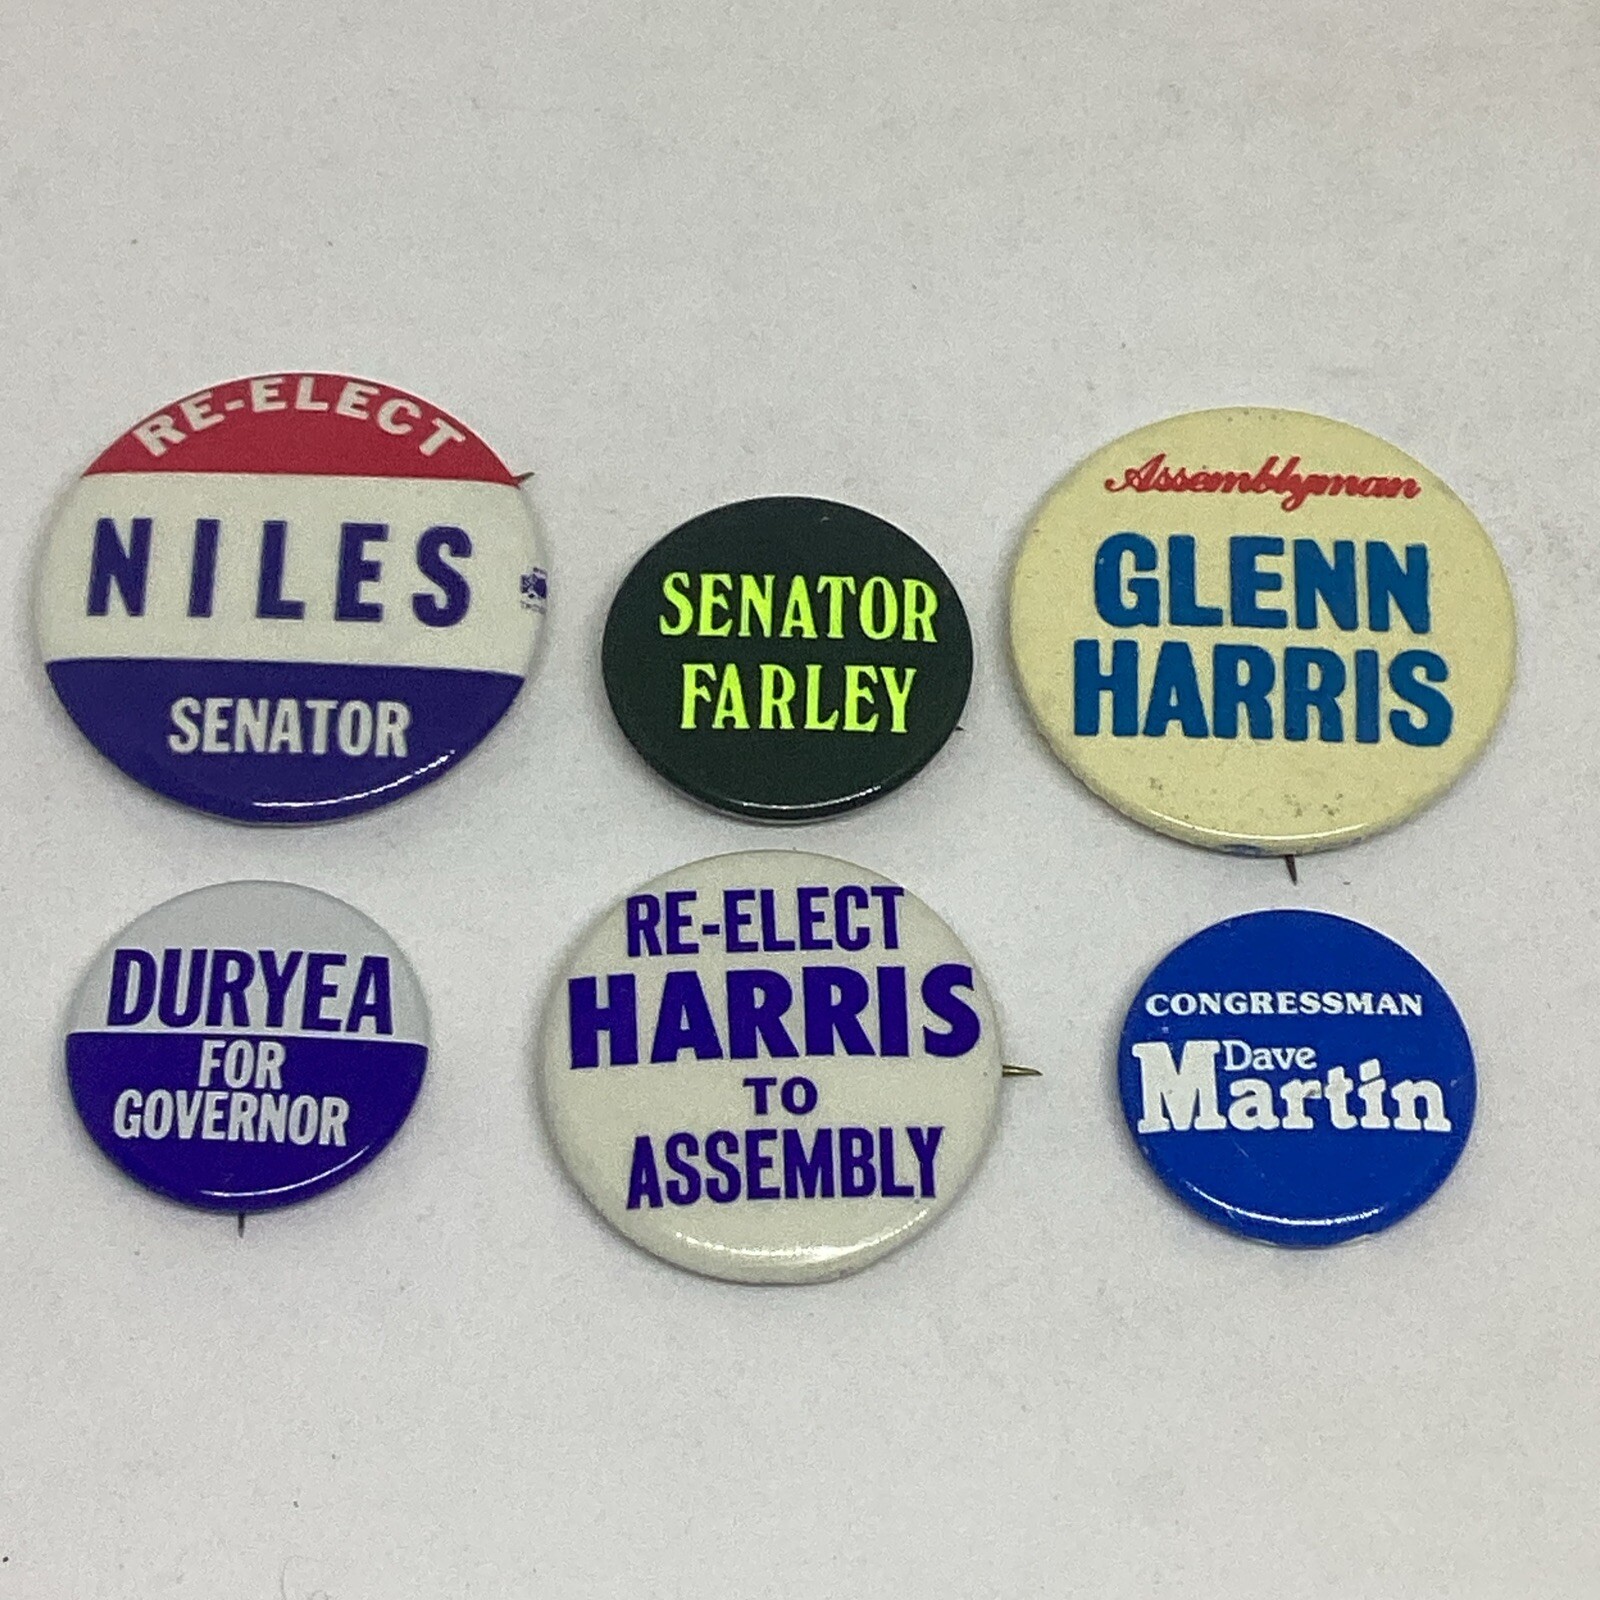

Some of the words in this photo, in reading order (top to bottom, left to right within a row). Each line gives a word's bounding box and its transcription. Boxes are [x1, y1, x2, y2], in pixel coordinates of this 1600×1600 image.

[132, 375, 466, 457] RE-ELECT
[1105, 453, 1421, 511] Assemblyman
[86, 518, 473, 627] NILES
[659, 572, 938, 643] SENATOR
[1094, 532, 1431, 634] GLENN
[168, 697, 412, 757] SENATOR
[680, 663, 917, 733] FARLEY
[1073, 638, 1454, 747] HARRIS
[626, 885, 904, 957] RE-ELECT
[107, 948, 393, 1035] DURYEA
[568, 963, 981, 1070] HARRIS
[1145, 991, 1422, 1016] CONGRESSMAN
[198, 1039, 285, 1090] FOR
[1132, 1040, 1451, 1133] Martin
[1223, 1040, 1317, 1071] Dave
[113, 1089, 349, 1146] GOVERNOR
[742, 1076, 818, 1115] TO
[627, 1126, 943, 1210] ASSEMBLY
